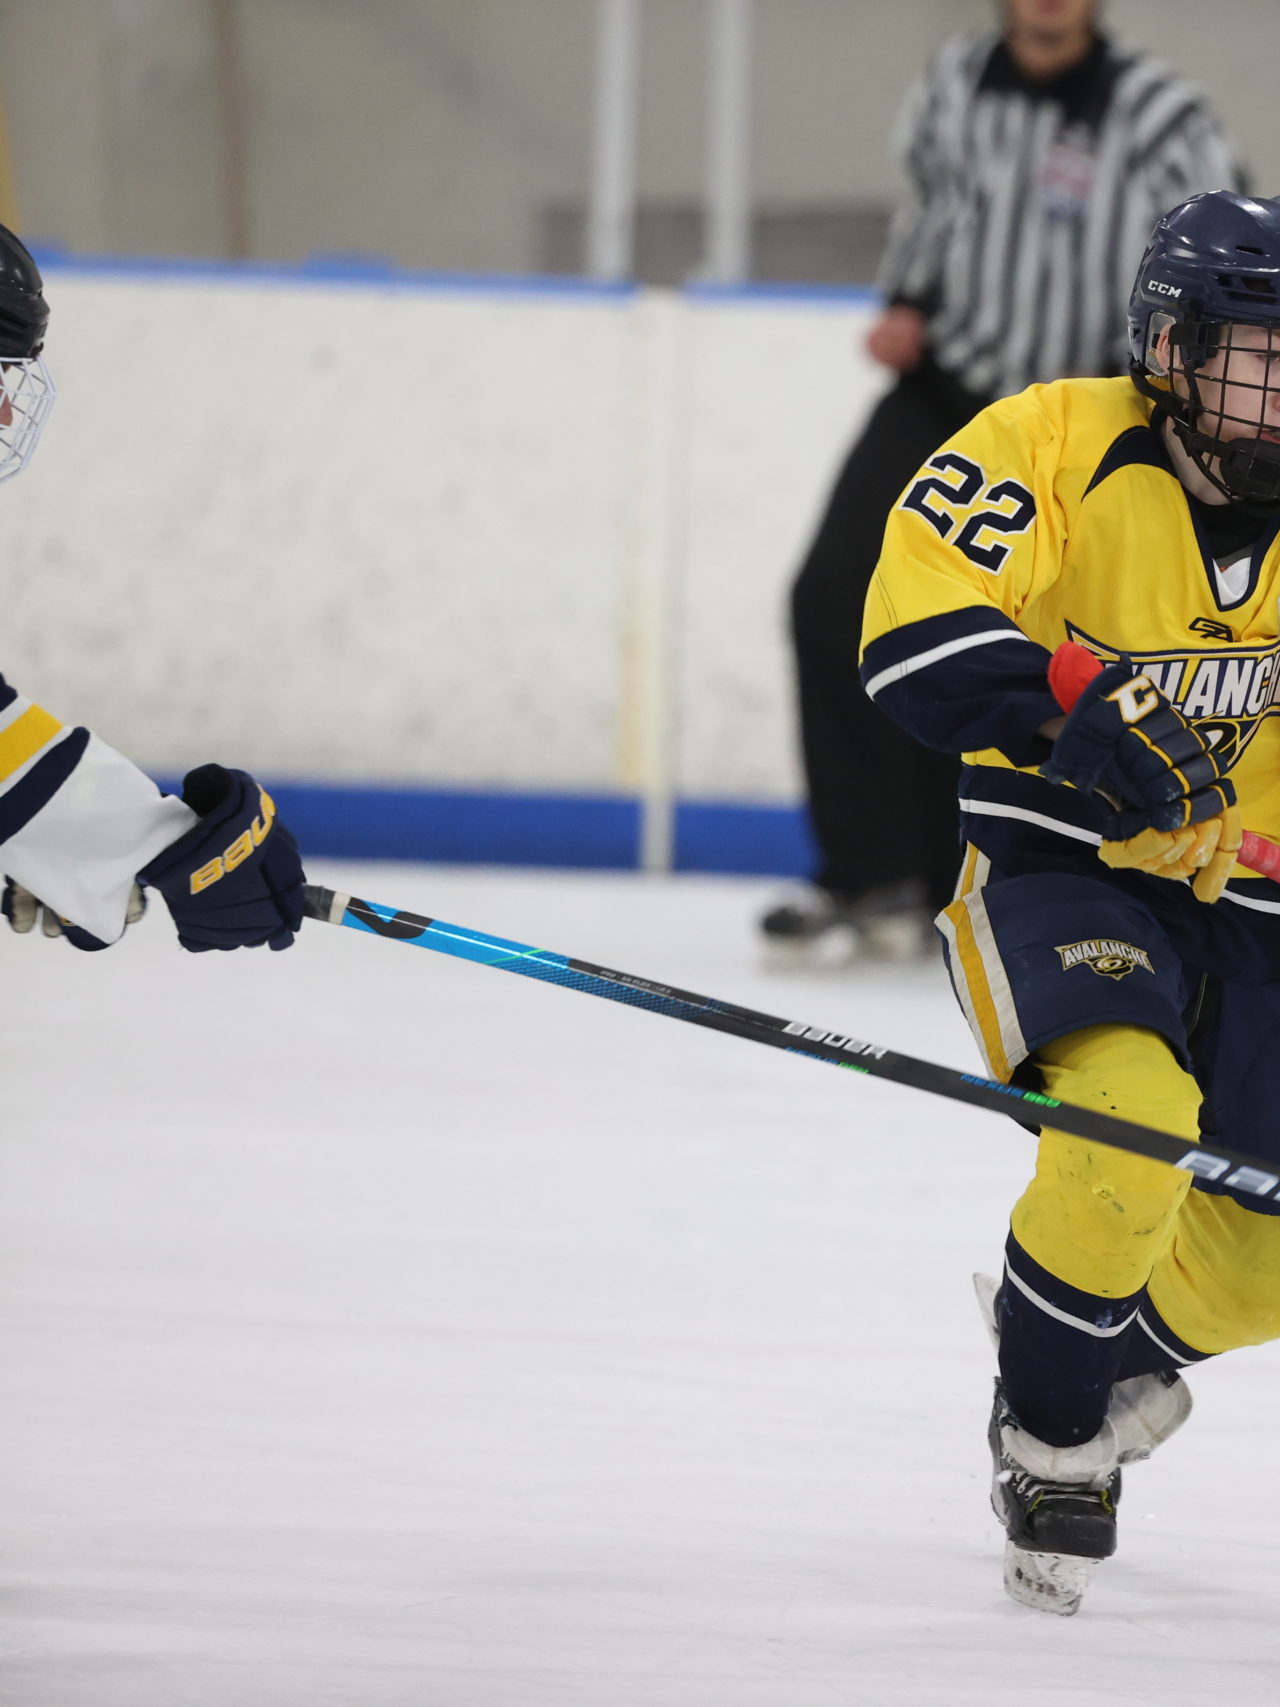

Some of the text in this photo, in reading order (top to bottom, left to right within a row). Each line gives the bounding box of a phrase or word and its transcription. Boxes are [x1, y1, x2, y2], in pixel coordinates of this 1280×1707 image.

[1147, 279, 1183, 298] CCM
[898, 450, 1037, 577] 22
[1063, 941, 1149, 968] AVALANCHE
